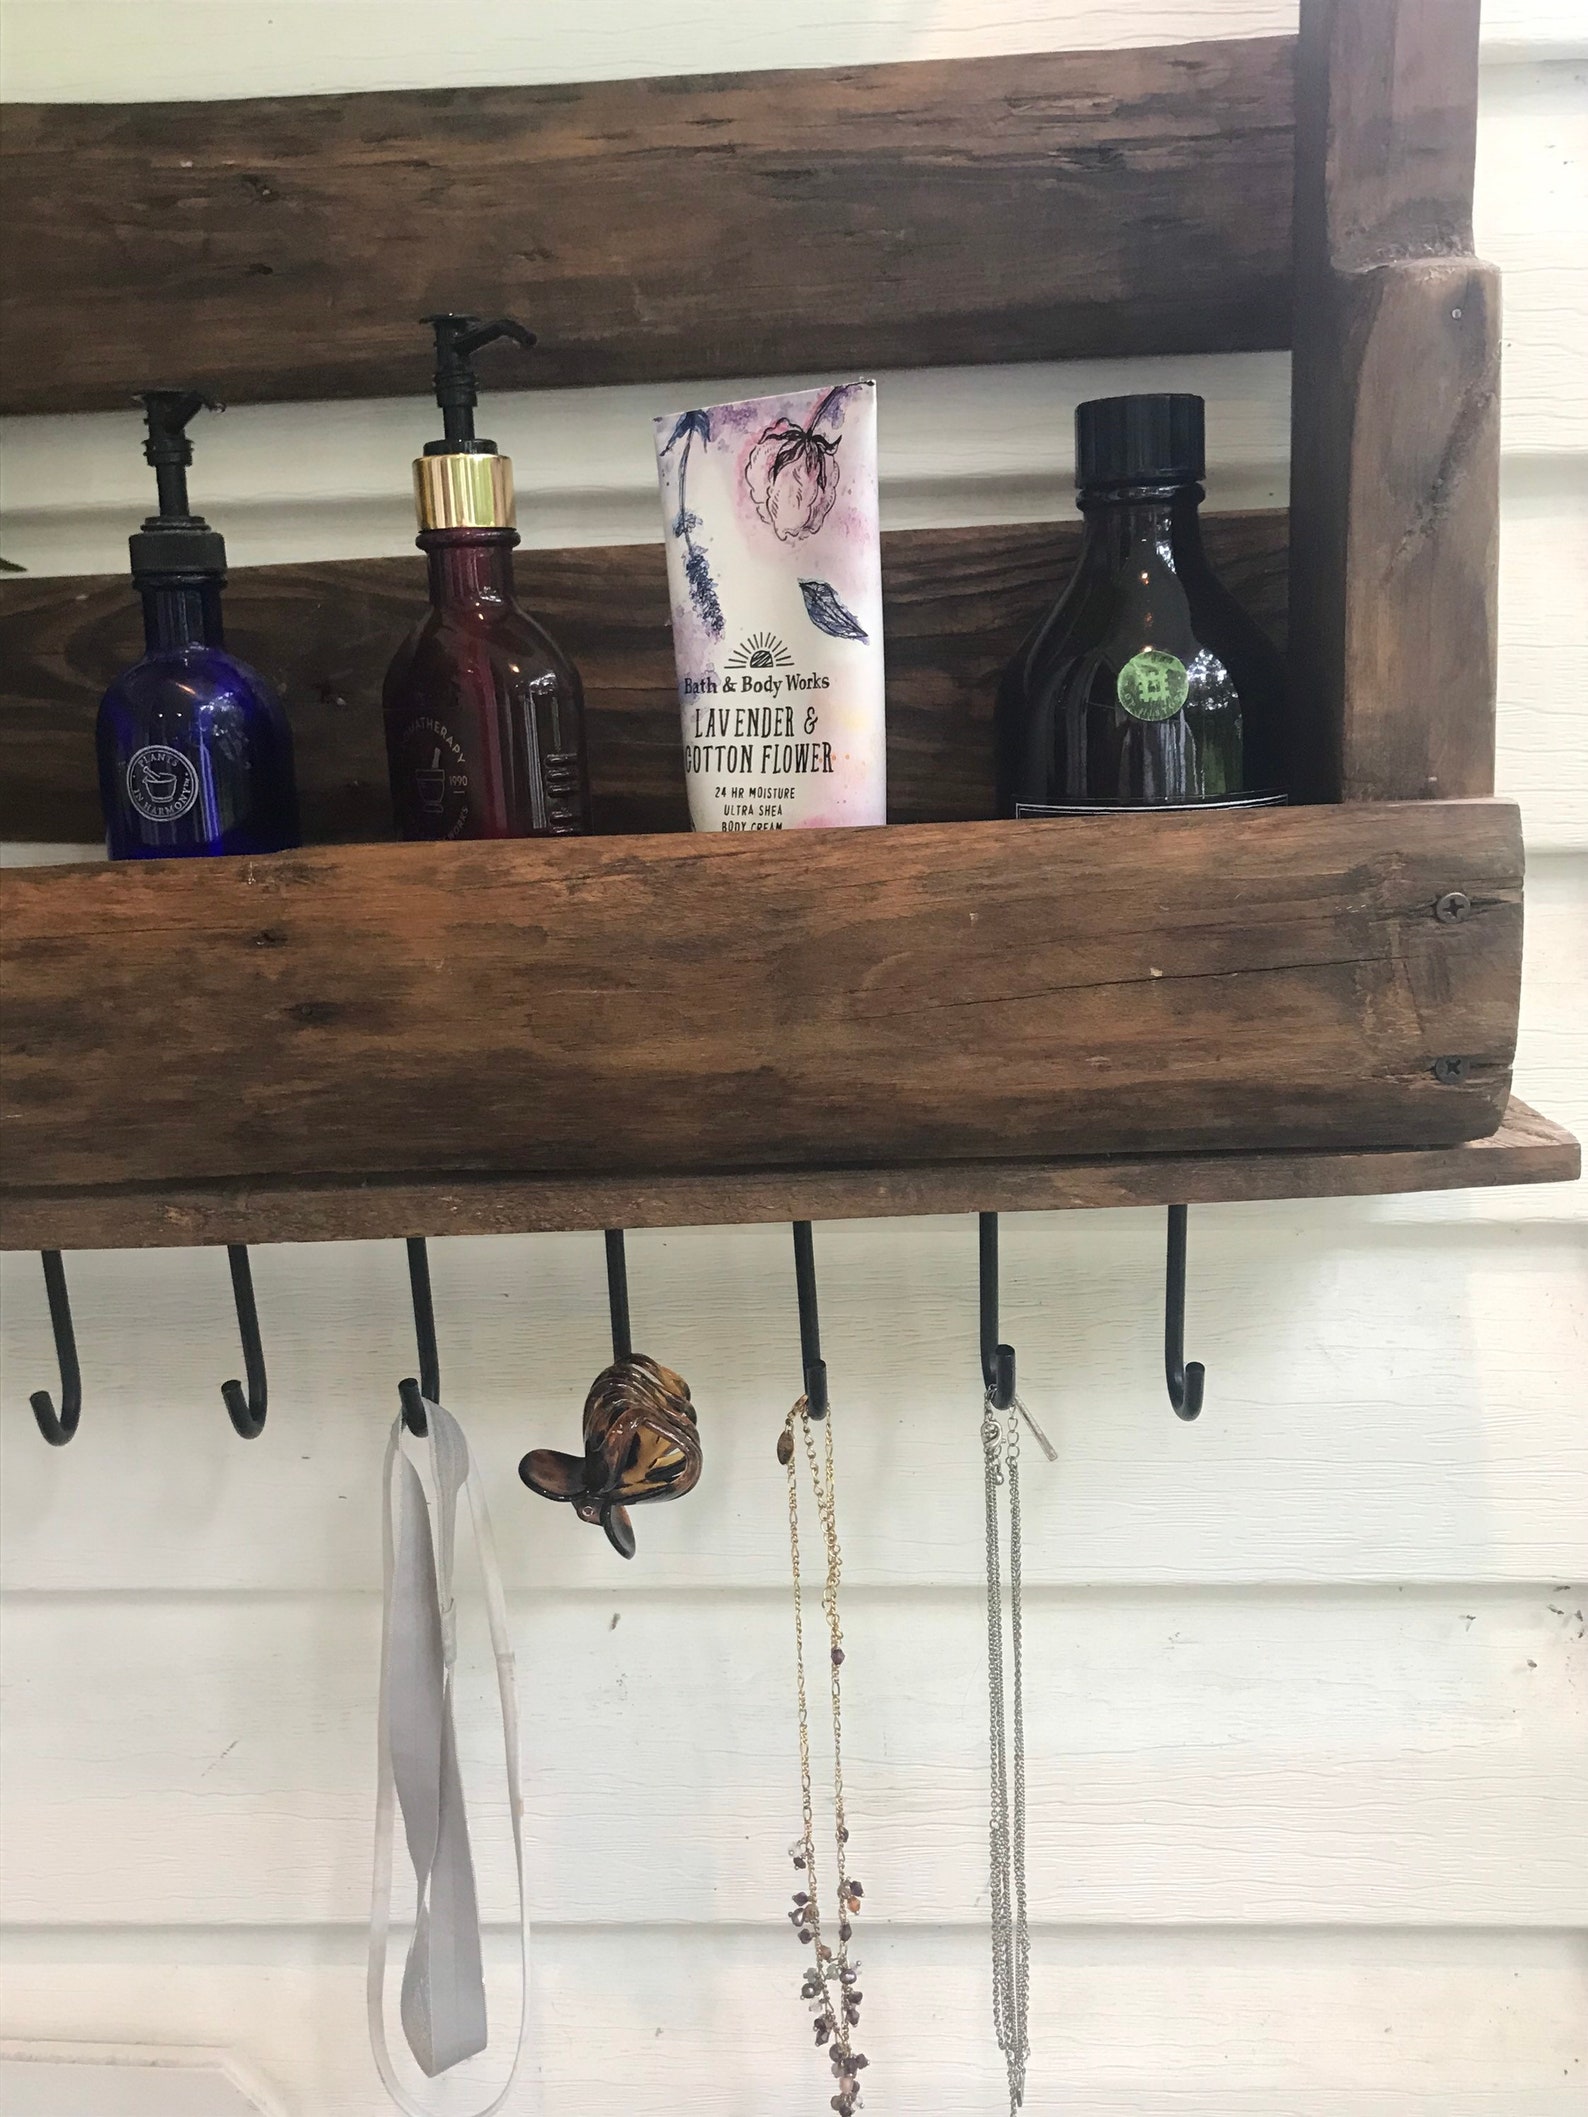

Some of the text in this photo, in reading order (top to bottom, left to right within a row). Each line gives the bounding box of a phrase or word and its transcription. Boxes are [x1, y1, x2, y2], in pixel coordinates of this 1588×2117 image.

[684, 672, 830, 698] Bath & Body Works
[695, 706, 818, 739] LAVENDER &
[137, 753, 179, 767] PLANTS
[685, 741, 834, 775] COTTON FLOWER
[449, 775, 468, 787] 1990
[134, 789, 144, 802] IN
[714, 785, 796, 799] 24 HR MOISTURE
[723, 804, 783, 817] ULTRA SHEA
[721, 821, 747, 832] BODY
